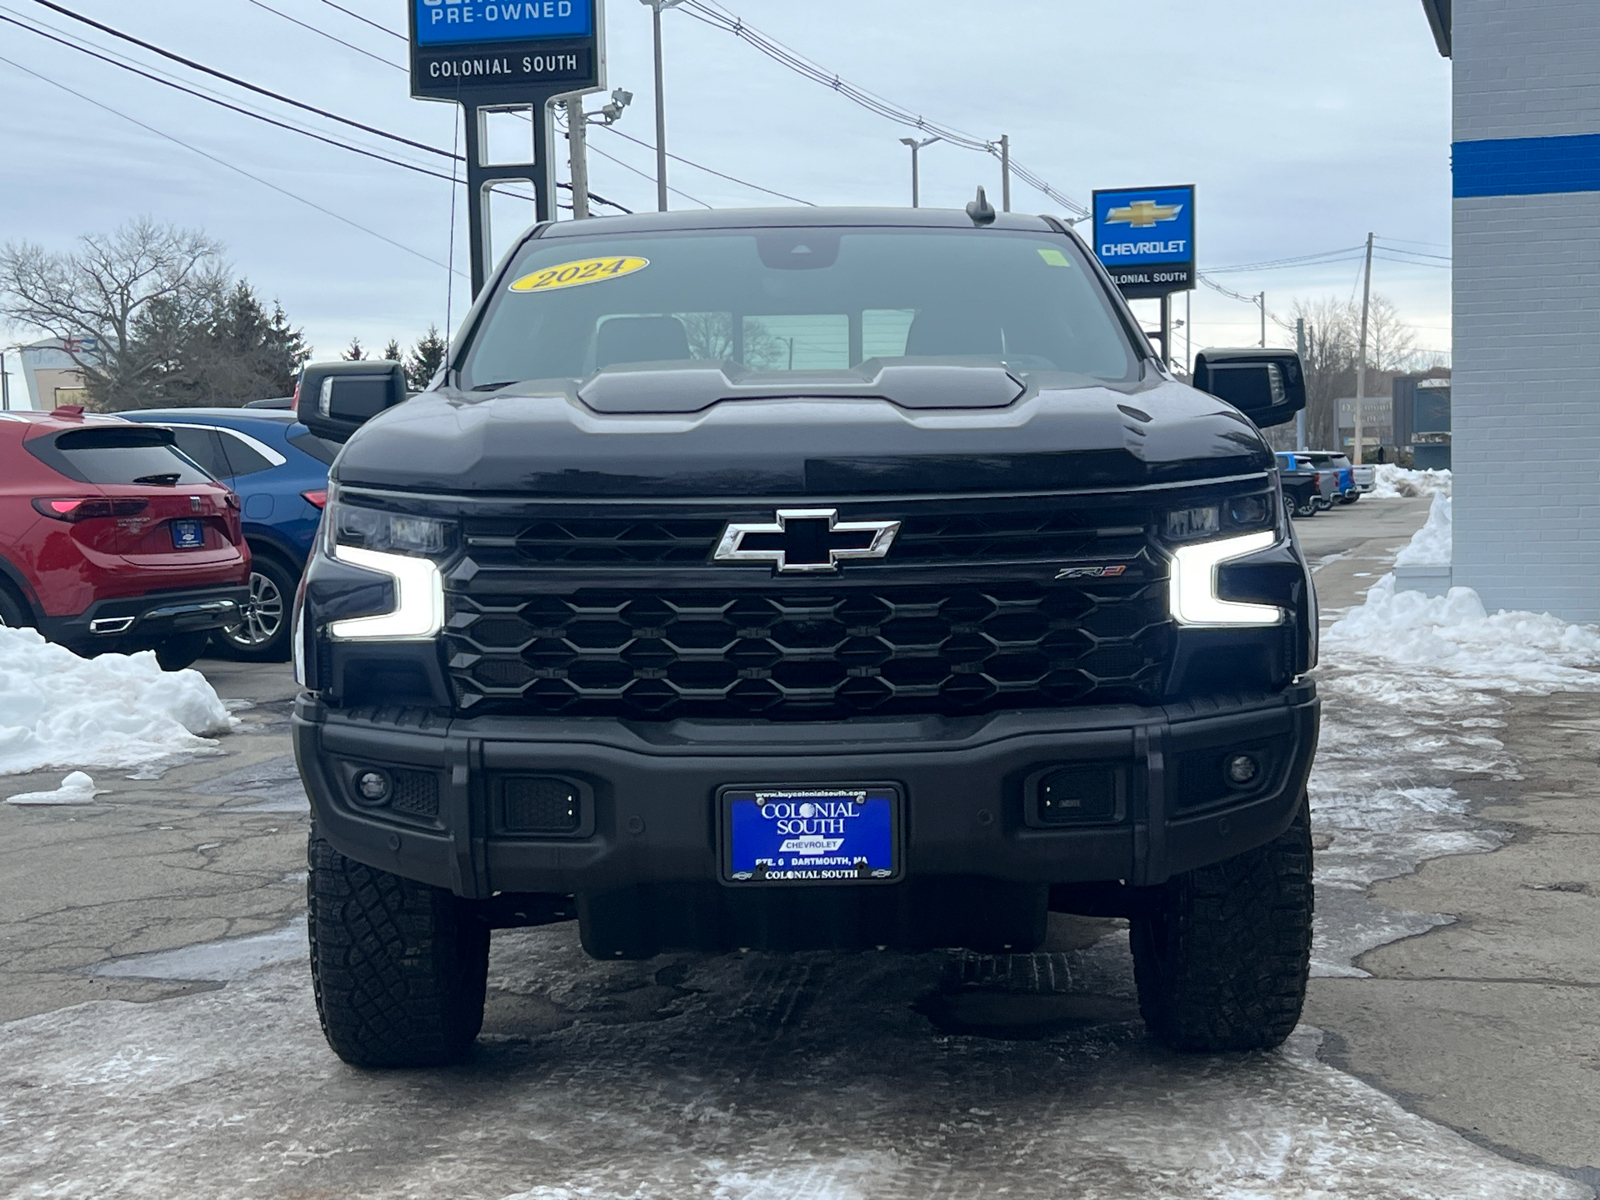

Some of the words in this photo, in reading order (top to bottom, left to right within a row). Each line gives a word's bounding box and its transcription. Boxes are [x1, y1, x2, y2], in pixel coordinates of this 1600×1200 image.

[431, 1, 571, 24] PRE-OWNED
[430, 58, 512, 78] COLONIAL
[522, 55, 577, 73] SOUTH
[1102, 240, 1186, 256] CHEVROLET
[531, 258, 627, 289] 2024
[1153, 272, 1187, 283] SOUTH
[1054, 565, 1126, 579] ZR2
[755, 791, 867, 799] www.buycolonialsouth.com
[762, 802, 860, 819] COLONIAL
[777, 818, 844, 835] SOUTH
[786, 841, 837, 849] CHEVROLET
[778, 858, 785, 866] 6
[792, 857, 852, 867] DARTMOUTH,
[853, 857, 868, 865] MA
[765, 870, 820, 880] COLONIAL
[821, 869, 859, 879] SOUTH
